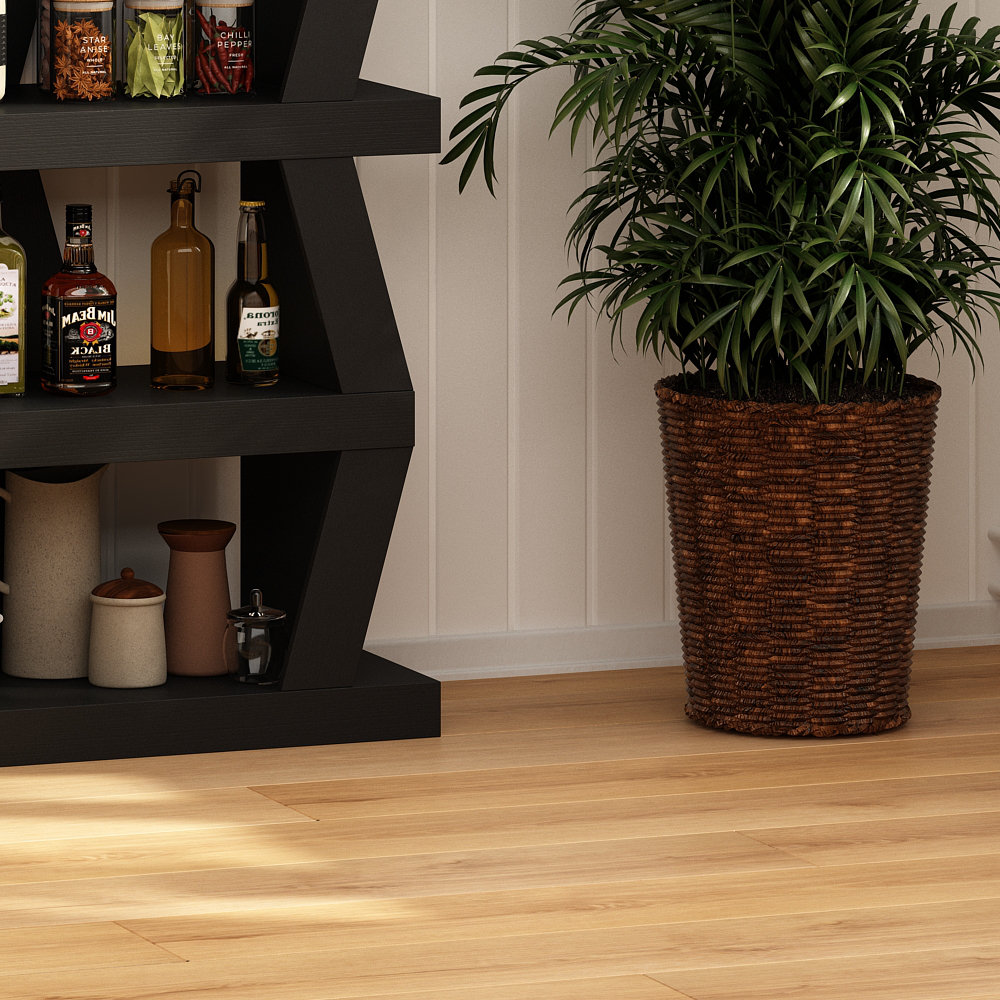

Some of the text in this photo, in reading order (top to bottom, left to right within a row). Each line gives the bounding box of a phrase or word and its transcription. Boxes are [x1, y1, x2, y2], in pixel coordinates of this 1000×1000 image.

[157, 33, 175, 41] BAY
[220, 31, 250, 39] CHILLI
[82, 36, 106, 44] STAR
[147, 43, 181, 51] LEAVES
[217, 40, 252, 49] PEPPER
[80, 45, 108, 53] ANISE
